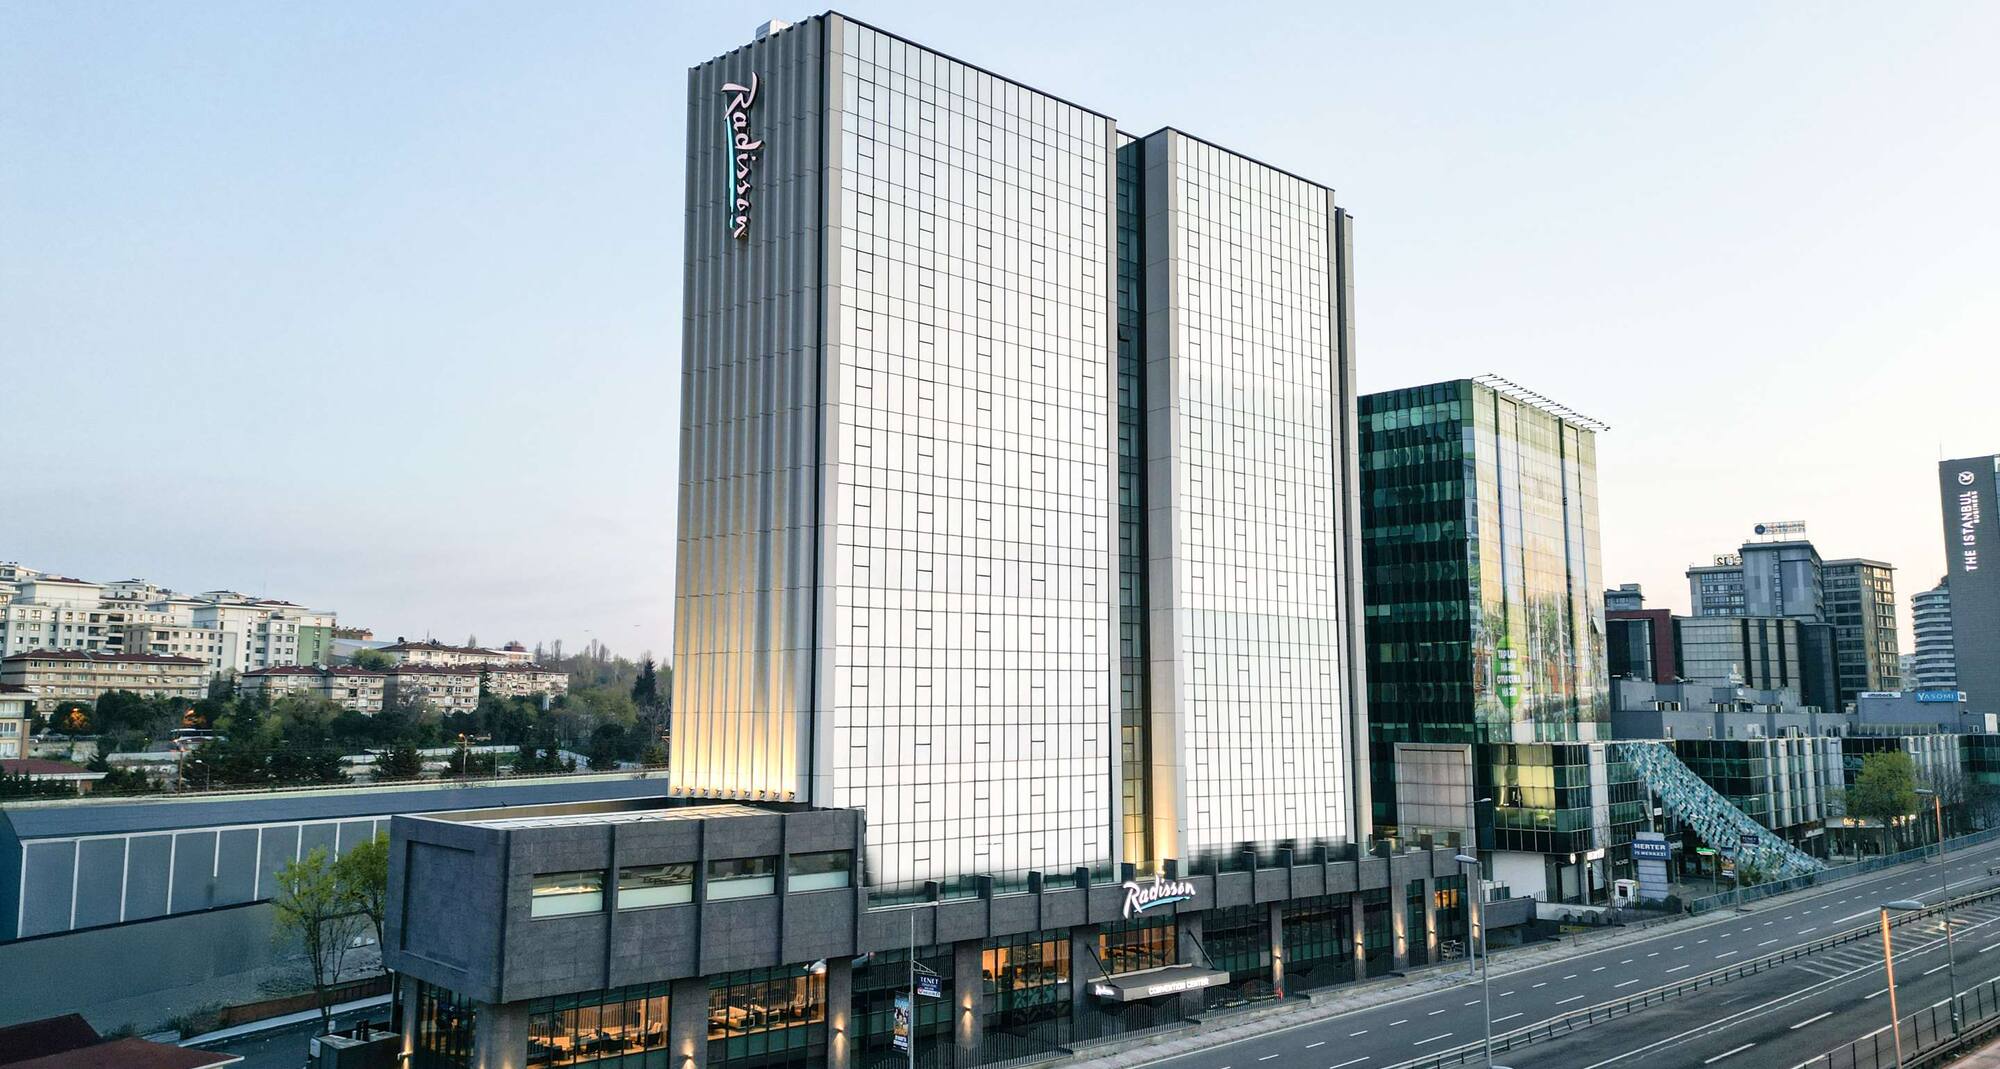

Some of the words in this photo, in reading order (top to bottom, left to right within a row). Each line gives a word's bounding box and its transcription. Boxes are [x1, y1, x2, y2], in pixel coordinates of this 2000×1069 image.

[721, 71, 762, 239] Radisson
[1964, 549, 1978, 572] THE
[1123, 874, 1196, 919] Radisson
